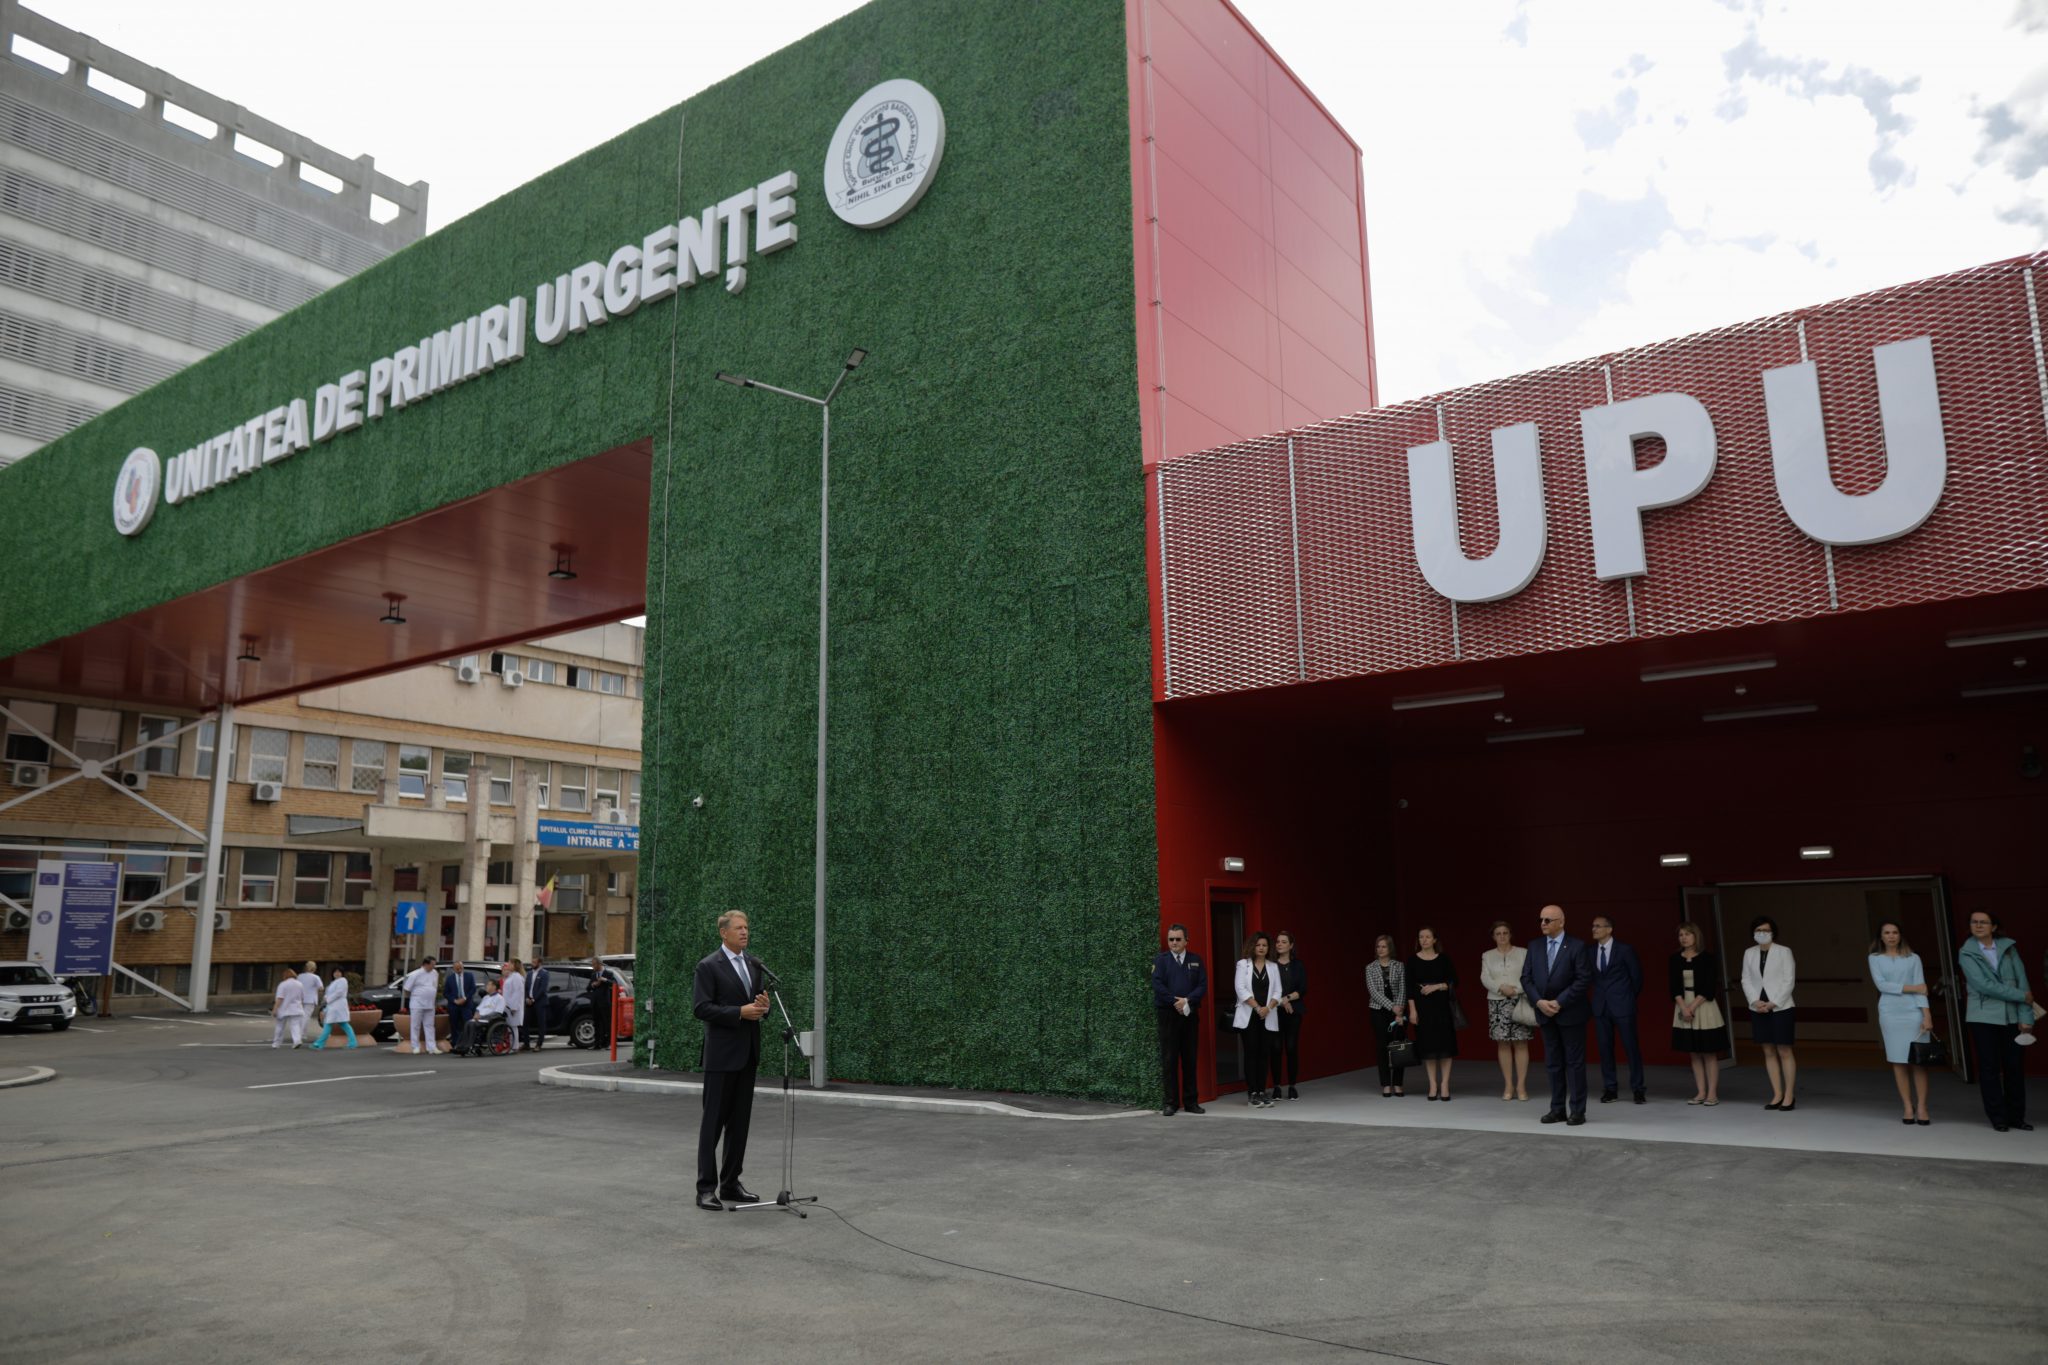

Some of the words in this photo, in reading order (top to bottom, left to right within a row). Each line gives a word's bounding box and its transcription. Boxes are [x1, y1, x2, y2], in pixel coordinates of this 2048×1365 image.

[848, 191, 870, 204] NIHIL
[874, 181, 892, 194] SINE
[895, 172, 913, 185] DEO
[164, 398, 310, 505] UNITATEA
[313, 370, 366, 442] DE
[368, 297, 527, 419] PRIMIRI
[535, 170, 798, 346] URGENȚE
[1407, 335, 1947, 603] UPU
[540, 825, 568, 834] SPITALUL
[568, 827, 588, 835] CLINIC
[567, 835, 613, 848] INTRARE
[617, 839, 625, 849] A
